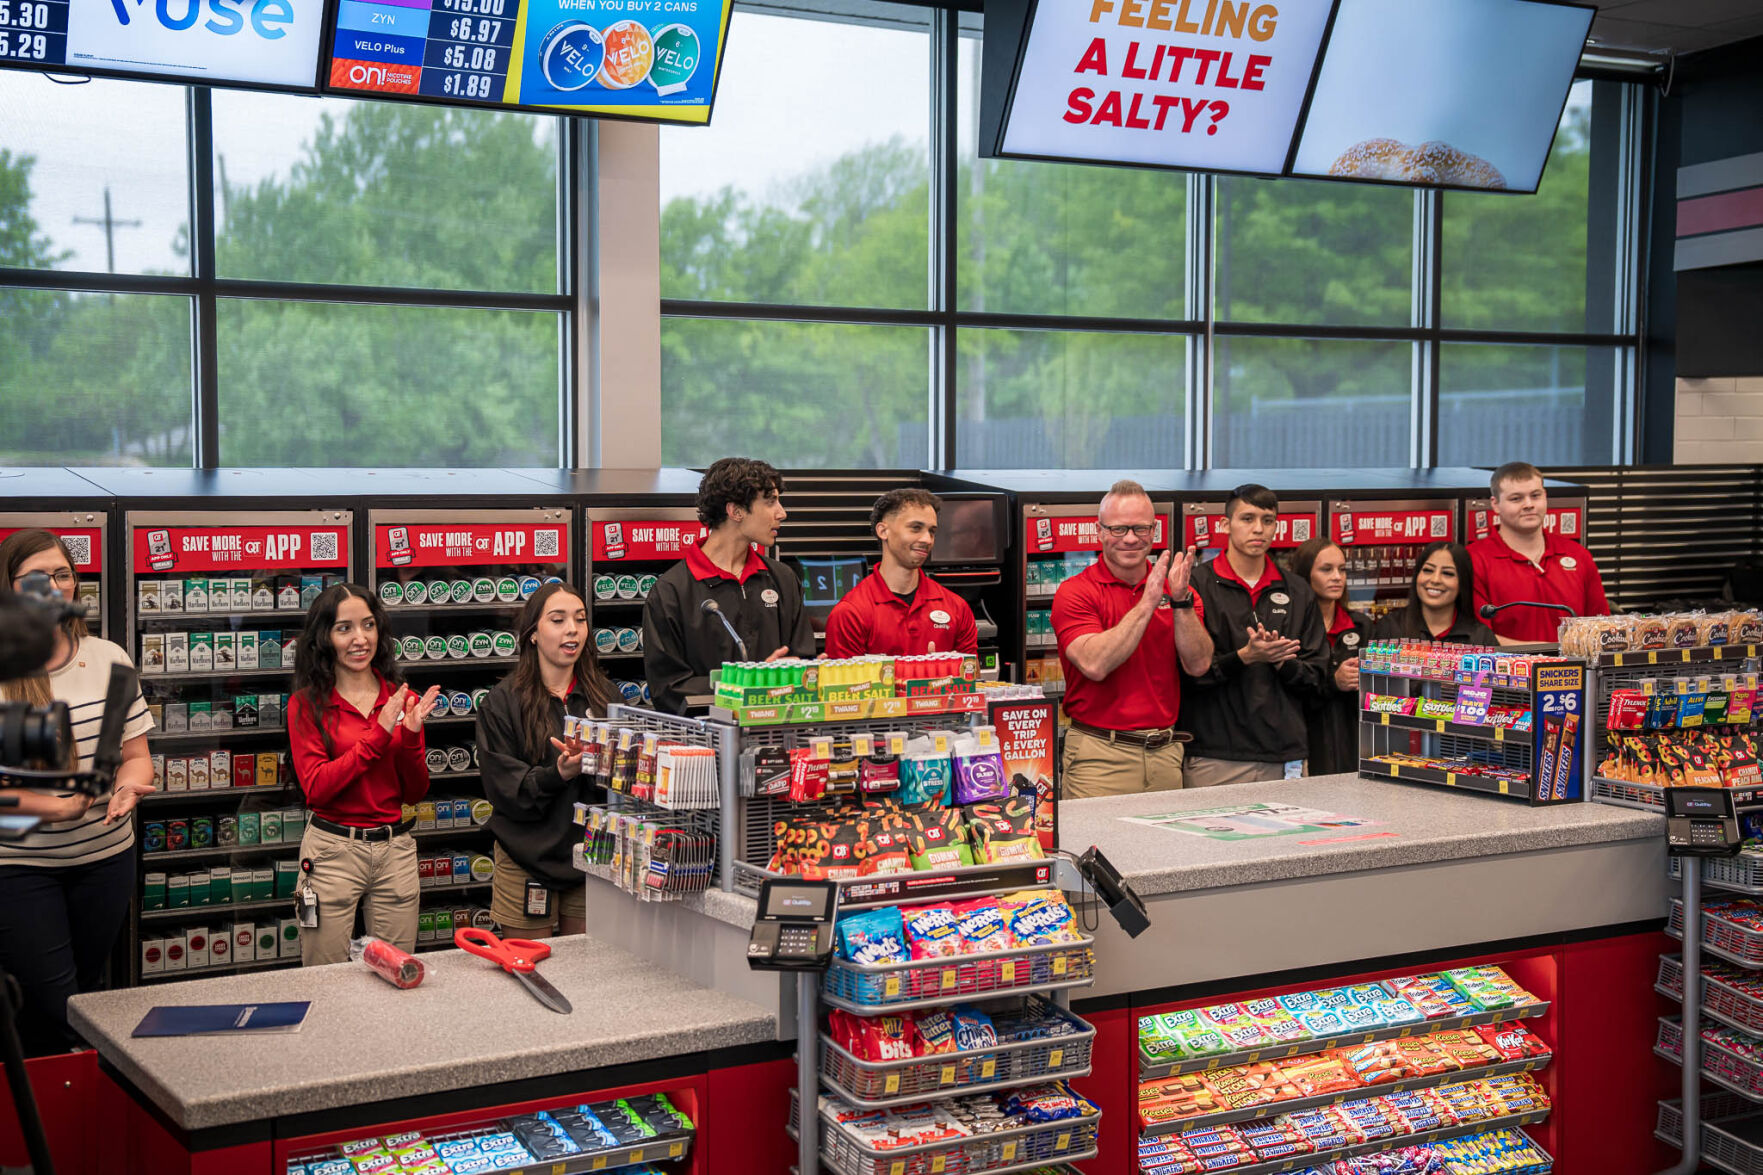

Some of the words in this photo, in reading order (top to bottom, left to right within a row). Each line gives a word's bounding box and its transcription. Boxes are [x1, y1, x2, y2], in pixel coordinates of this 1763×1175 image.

[558, 0, 595, 10] WHEN
[599, 0, 625, 11] YOU
[627, 1, 651, 11] BUY
[654, 2, 661, 11] 2
[664, 2, 698, 12] CANS
[371, 13, 396, 25] ZYN
[1089, 0, 1279, 42] FEELING
[450, 17, 502, 43] $6.97
[355, 40, 382, 52] VELO
[384, 44, 405, 55] Plus
[606, 41, 650, 66] VELO
[443, 45, 497, 71] $5.08
[560, 40, 595, 77] VELO
[656, 46, 694, 70] VELO
[1073, 37, 1108, 76] A
[1121, 41, 1273, 91] LITTLE
[443, 73, 492, 98] $1.89
[1062, 87, 1230, 136] SALTY?
[1059, 523, 1077, 536] SAVE
[1078, 522, 1098, 535] MORE
[1358, 518, 1374, 530] SAVE
[1375, 517, 1392, 529] MORE
[1405, 517, 1426, 537] APP
[419, 533, 444, 547] SAVE
[445, 532, 473, 547] MORE
[632, 528, 654, 542] SAVE
[656, 528, 680, 542] MORE
[682, 534, 696, 545] QT
[1078, 536, 1090, 544] WITH
[182, 536, 209, 552] SAVE
[212, 535, 242, 550] MORE
[245, 541, 262, 554] QT
[265, 534, 301, 560] APP
[475, 538, 490, 550] QT
[493, 531, 526, 556] APP
[656, 542, 670, 551] WITH
[670, 542, 680, 551] THE
[212, 552, 229, 562] WITH
[230, 551, 242, 561] THE
[446, 547, 461, 557] WITH
[462, 547, 473, 557] THE
[524, 582, 538, 590] ZYN
[1539, 668, 1579, 679] SNICKERS
[945, 682, 972, 695] SALT
[1539, 679, 1562, 688] SHARE
[1564, 678, 1579, 687] SIZE
[770, 686, 793, 697] TWANG
[785, 692, 815, 704] SALT
[863, 688, 891, 700] SALT
[1462, 689, 1487, 698] MOJO
[834, 704, 859, 713] TWANG
[915, 701, 939, 709] TWANG
[1370, 701, 1403, 713] Skittles
[1422, 702, 1456, 713] Skittles
[1542, 694, 1555, 712] 2
[1559, 692, 1577, 712] $6
[749, 710, 776, 718] TWANG
[1002, 710, 1030, 721] SAVE
[1032, 708, 1047, 719] ON
[1484, 713, 1514, 724] kittles
[1008, 719, 1042, 730] EVERY
[1013, 730, 1037, 740] TRIP
[1003, 741, 1011, 751] &
[1014, 738, 1047, 750] EVERY
[1004, 749, 1046, 760] GALLON
[1539, 750, 1553, 800] SNICKERS
[1556, 746, 1571, 798] SNICKERS
[929, 850, 960, 863] GUMMY
[913, 909, 956, 934] Nerds
[958, 908, 1001, 936] Nerds
[1014, 905, 1068, 933] Nerds
[1392, 977, 1413, 985] Trident
[1464, 981, 1486, 989] Trident
[1286, 993, 1312, 1008] Extra
[1321, 993, 1347, 1008] Extra
[1355, 988, 1382, 1003] Extra
[1408, 989, 1430, 998] Trident
[1210, 1005, 1238, 1020] Extra
[1249, 999, 1276, 1015] Extra
[1422, 1003, 1445, 1011] Trident
[882, 1018, 903, 1034] RITZ
[1164, 1011, 1194, 1028] Extra
[1272, 1019, 1299, 1035] Extra
[1310, 1014, 1337, 1029] Extra
[1232, 1025, 1258, 1040] Extra
[1146, 1039, 1177, 1054] Extra
[1188, 1033, 1218, 1048] Extra
[879, 1039, 913, 1060] bits
[1207, 1068, 1233, 1081] STICKS
[1506, 1098, 1533, 1109] SNICKERS
[343, 1138, 378, 1153] Extra
[386, 1132, 421, 1147] Extra
[481, 1135, 514, 1151] Extra
[1190, 1135, 1220, 1146] SNICKERS
[400, 1149, 434, 1164] Extra
[441, 1142, 476, 1157] Extra
[358, 1155, 393, 1170] Extra
[456, 1157, 490, 1172] Extra
[495, 1152, 529, 1168] Extra
[1207, 1155, 1238, 1168] SNICKERS
